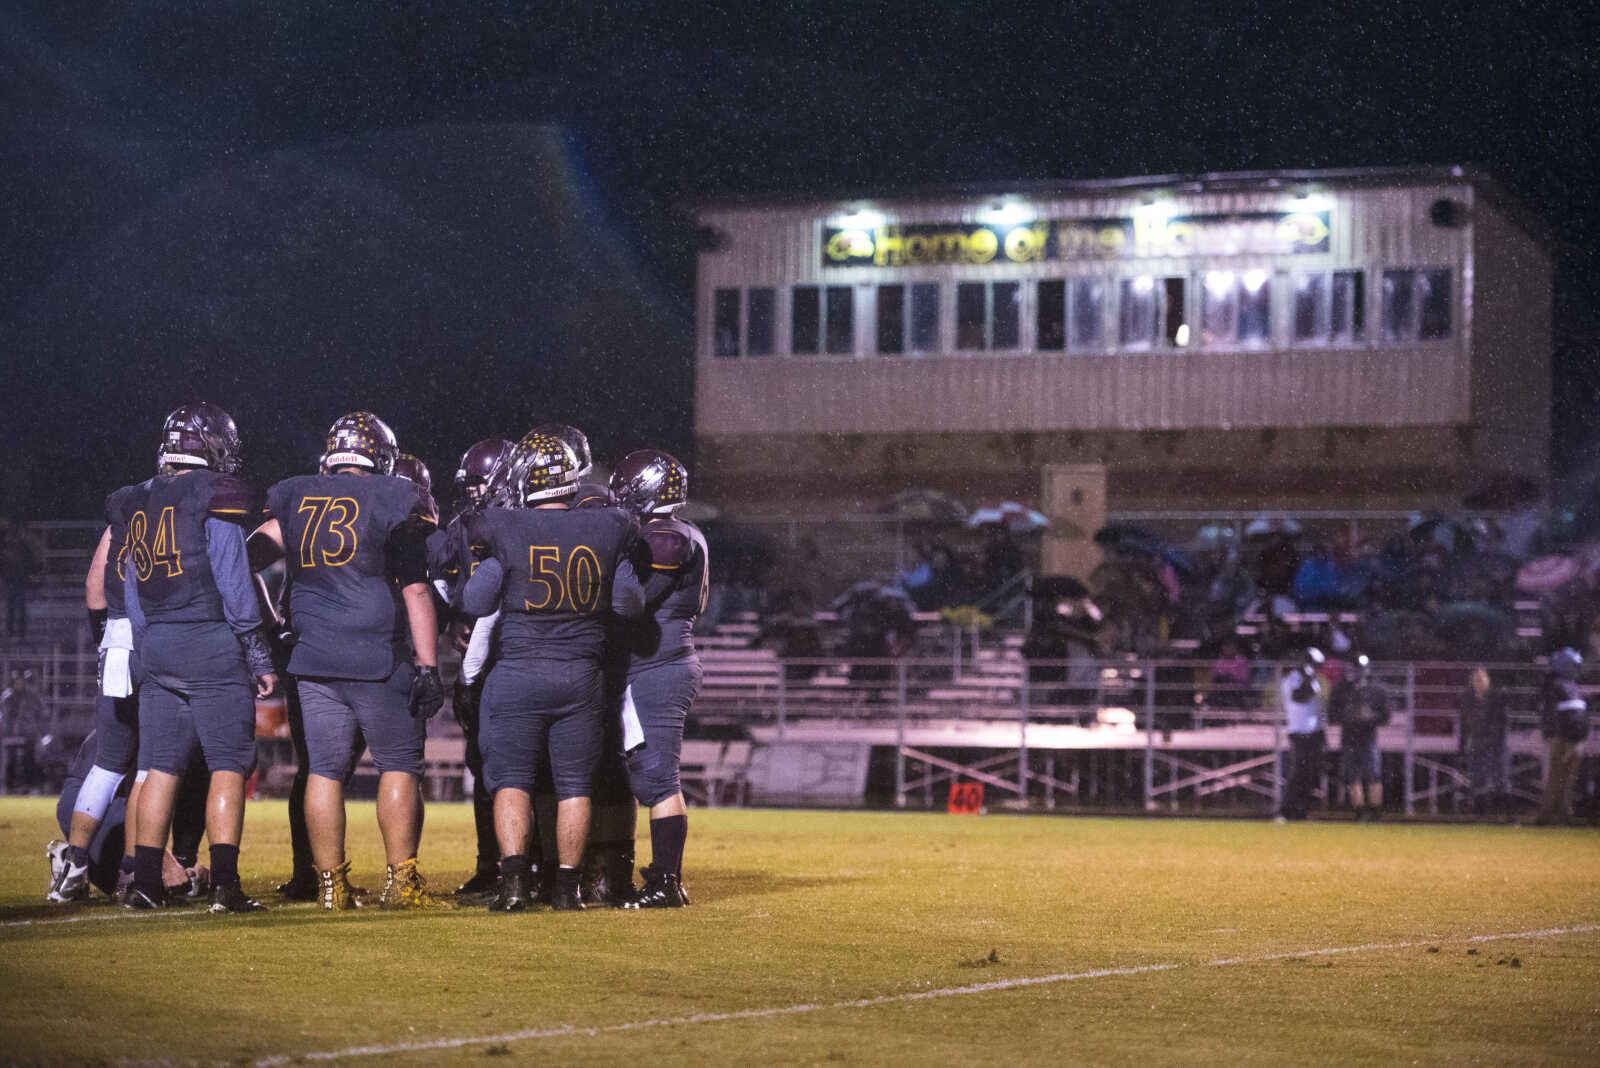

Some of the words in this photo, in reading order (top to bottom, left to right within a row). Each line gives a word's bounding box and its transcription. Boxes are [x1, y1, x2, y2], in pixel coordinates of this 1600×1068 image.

[128, 506, 184, 582] 84
[297, 496, 360, 568] 73
[524, 545, 602, 616] 50
[953, 786, 981, 810] 40
